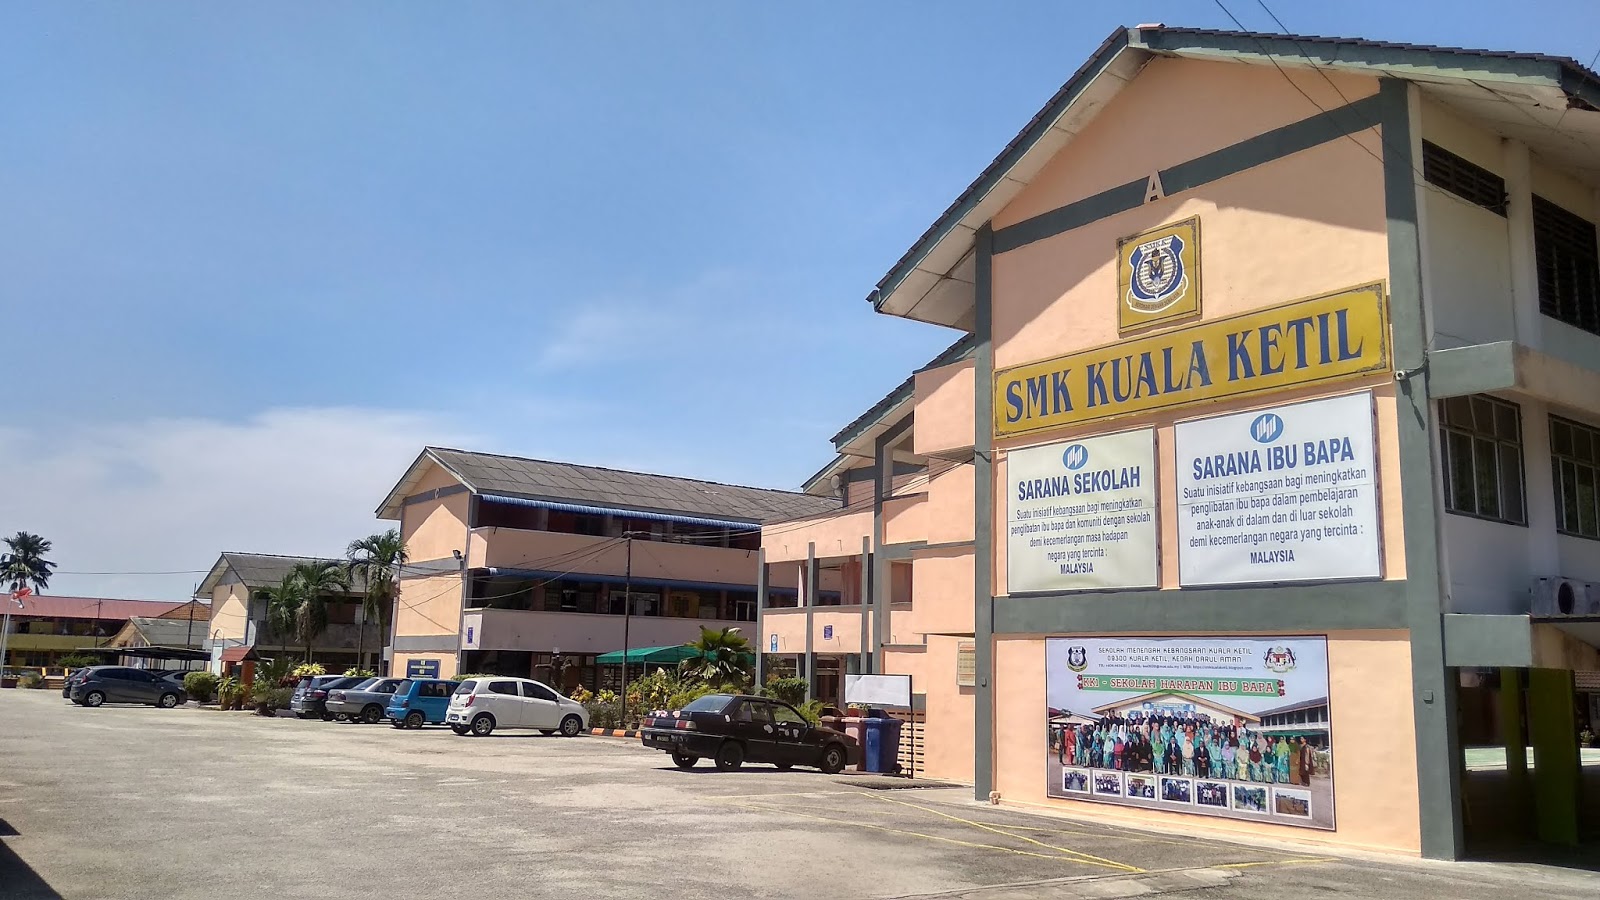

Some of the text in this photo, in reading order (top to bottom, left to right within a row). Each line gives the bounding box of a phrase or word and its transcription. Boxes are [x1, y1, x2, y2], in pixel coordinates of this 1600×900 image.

[1143, 169, 1165, 204] A
[1005, 308, 1364, 423] SMK KUALA KETIL
[1192, 436, 1354, 480] SARANA IBU BAPA
[1018, 466, 1140, 501] SARANA SEKOLAH
[1183, 467, 1366, 499] Suatu inisiatif kebangsaan bagi meningkatkan
[1017, 498, 1142, 520] Suatu inisiatif kebangsaan bagi meningkatkan
[1191, 487, 1358, 517] penglibatan ibu bapa dalam pembelajaran
[1010, 512, 1150, 537] penglibatan ibu bapa dan komuniti dengan sekolah
[1196, 505, 1353, 531] anak-anak di dalam dan di luar sekolah
[1030, 531, 1128, 547] demi kecemerlangan masa hadapan
[1190, 535, 1207, 548] demi
[1209, 531, 1268, 546] kecemerlangan
[1270, 529, 1298, 544] negara
[1300, 528, 1322, 542] yang
[1324, 523, 1358, 537] tercinta
[1048, 551, 1066, 562] negara
[1067, 550, 1081, 562] yang
[1082, 548, 1104, 558] tercinta
[1250, 550, 1295, 564] MALAYSIA
[1060, 562, 1094, 575] MALAYSIA
[1110, 678, 1156, 689] SEKOLAH
[1161, 679, 1213, 690] HARAPAN
[1218, 681, 1237, 691] IBU
[1242, 682, 1274, 693] BAPA
